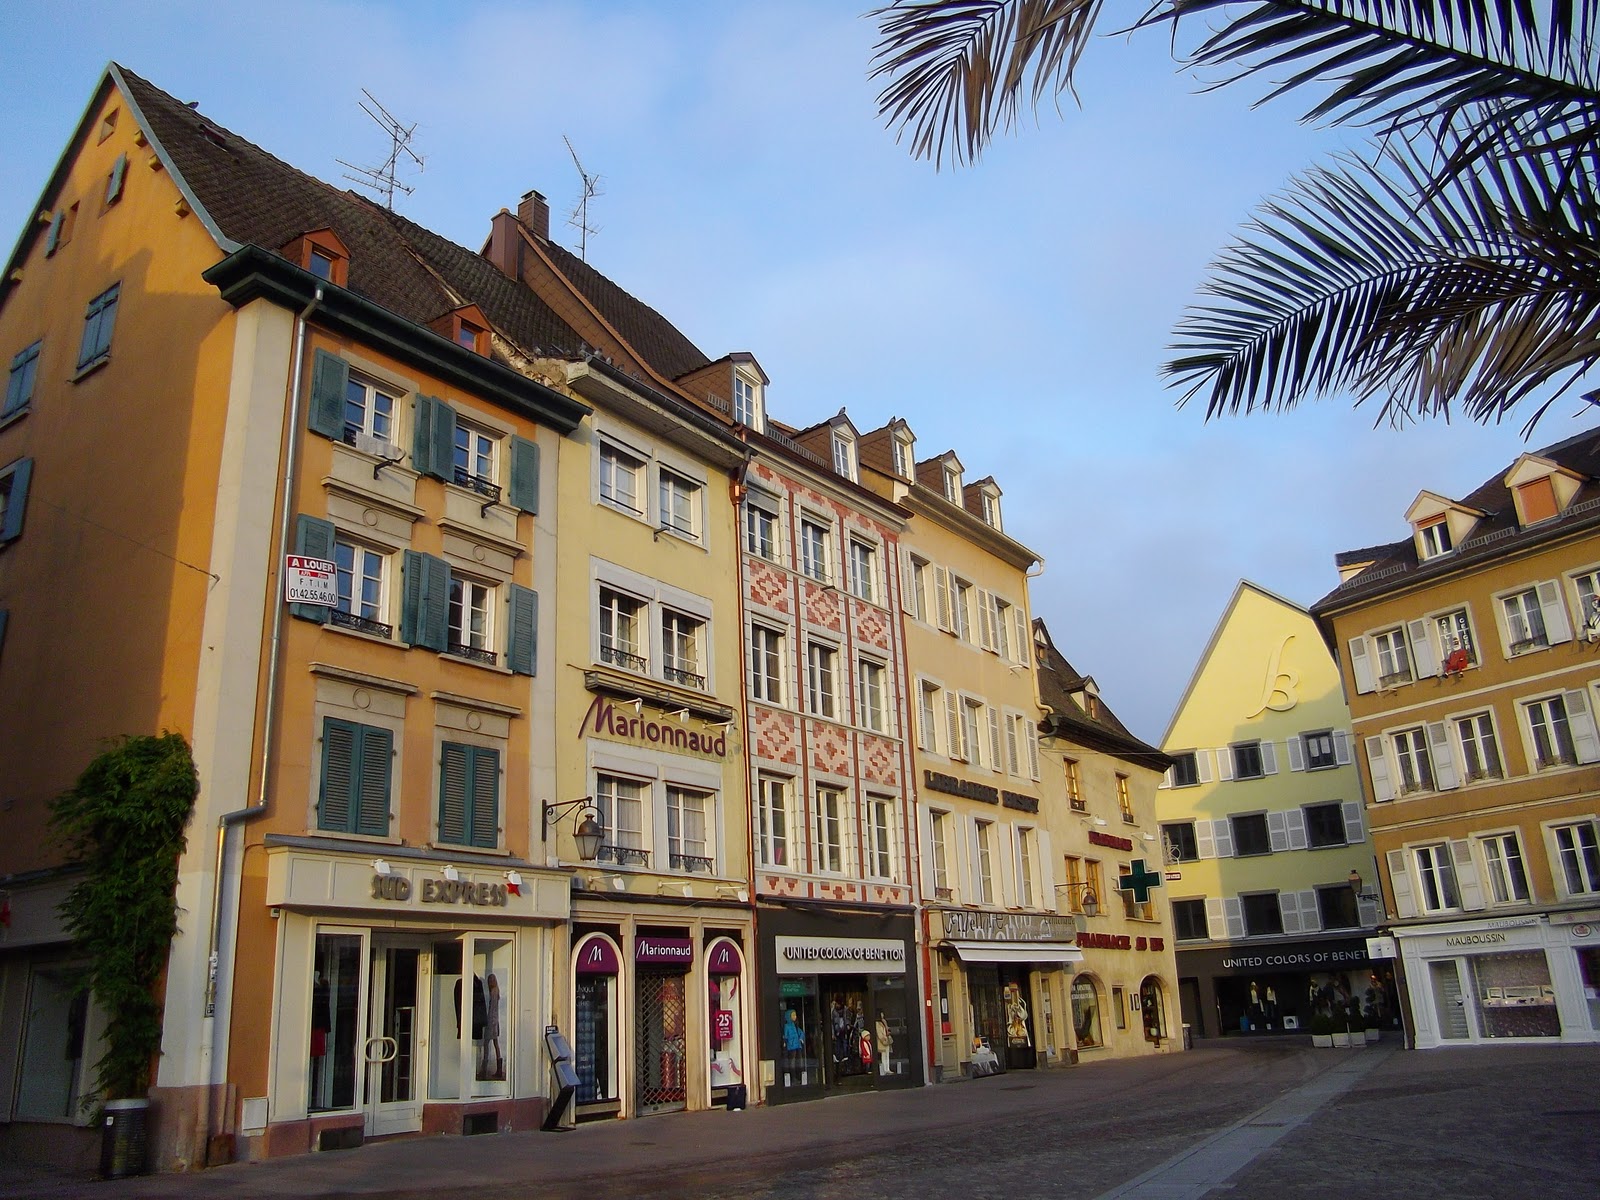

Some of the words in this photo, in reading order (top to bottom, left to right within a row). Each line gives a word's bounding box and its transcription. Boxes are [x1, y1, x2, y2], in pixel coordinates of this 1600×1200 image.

[291, 558, 300, 567] A
[303, 559, 333, 572] LOUER
[578, 694, 726, 757] Marionnaud
[371, 874, 411, 901] SUD
[421, 878, 508, 907] EXPRESS
[1446, 933, 1506, 946] MAUBOUSSIN
[636, 940, 691, 959] Marionnaud
[784, 947, 819, 960] UNITED
[820, 947, 852, 960] COLORS
[853, 947, 865, 960] OF
[865, 948, 905, 960] BENETTON
[1222, 957, 1262, 968] UNITED
[1266, 953, 1311, 966] COLORS
[1313, 951, 1329, 962] OF
[1332, 950, 1367, 961] BENET
